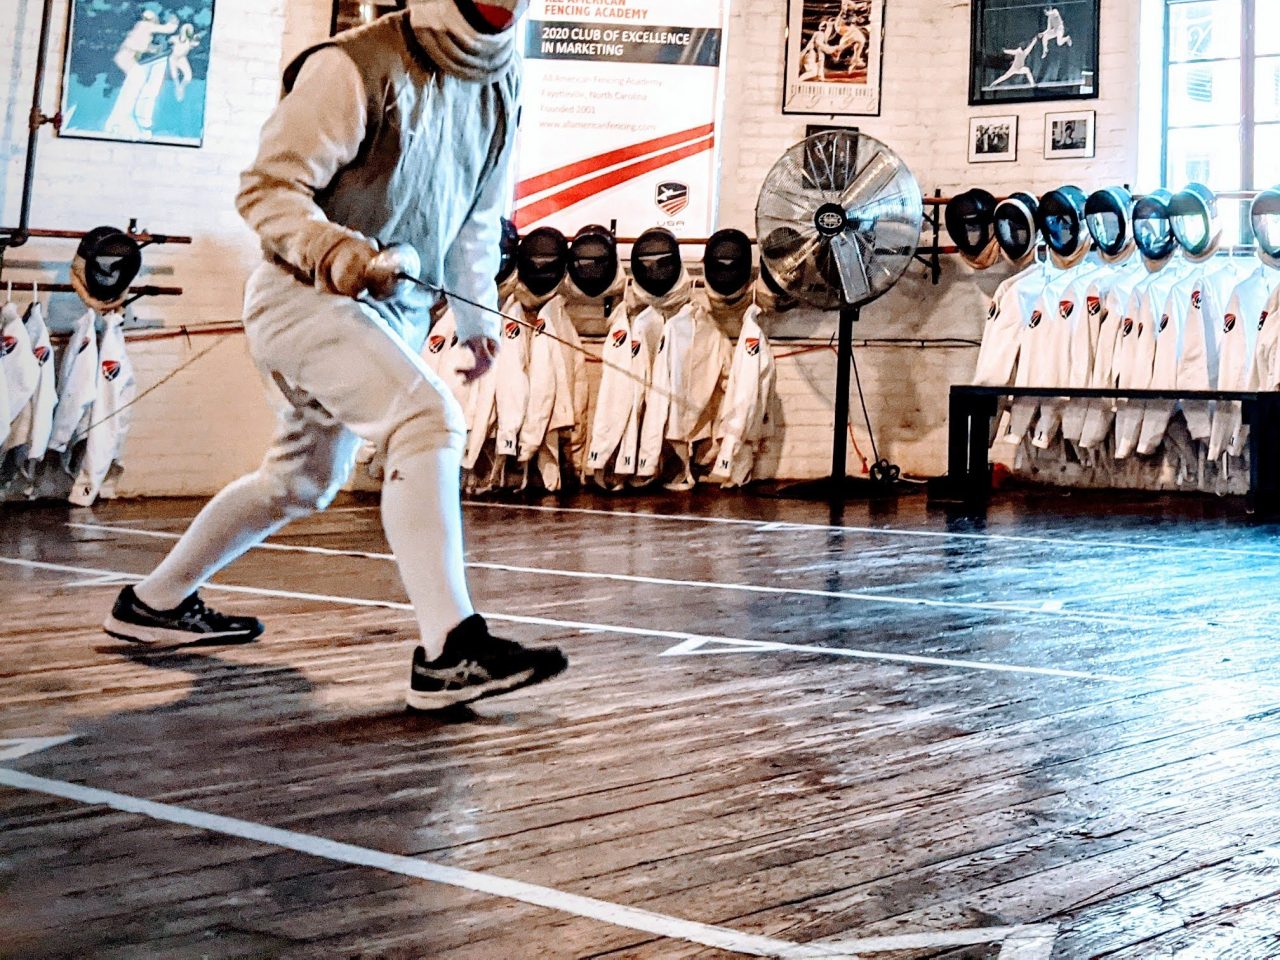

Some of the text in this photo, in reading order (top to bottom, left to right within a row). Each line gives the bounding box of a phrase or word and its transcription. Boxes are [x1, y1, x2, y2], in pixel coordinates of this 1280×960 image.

[544, 5, 649, 20] FENCING ACADEMY
[542, 27, 691, 46] 2020 CLUB OF EXCELLENCE
[541, 42, 625, 57] IN MARKETING
[589, 90, 613, 100] North
